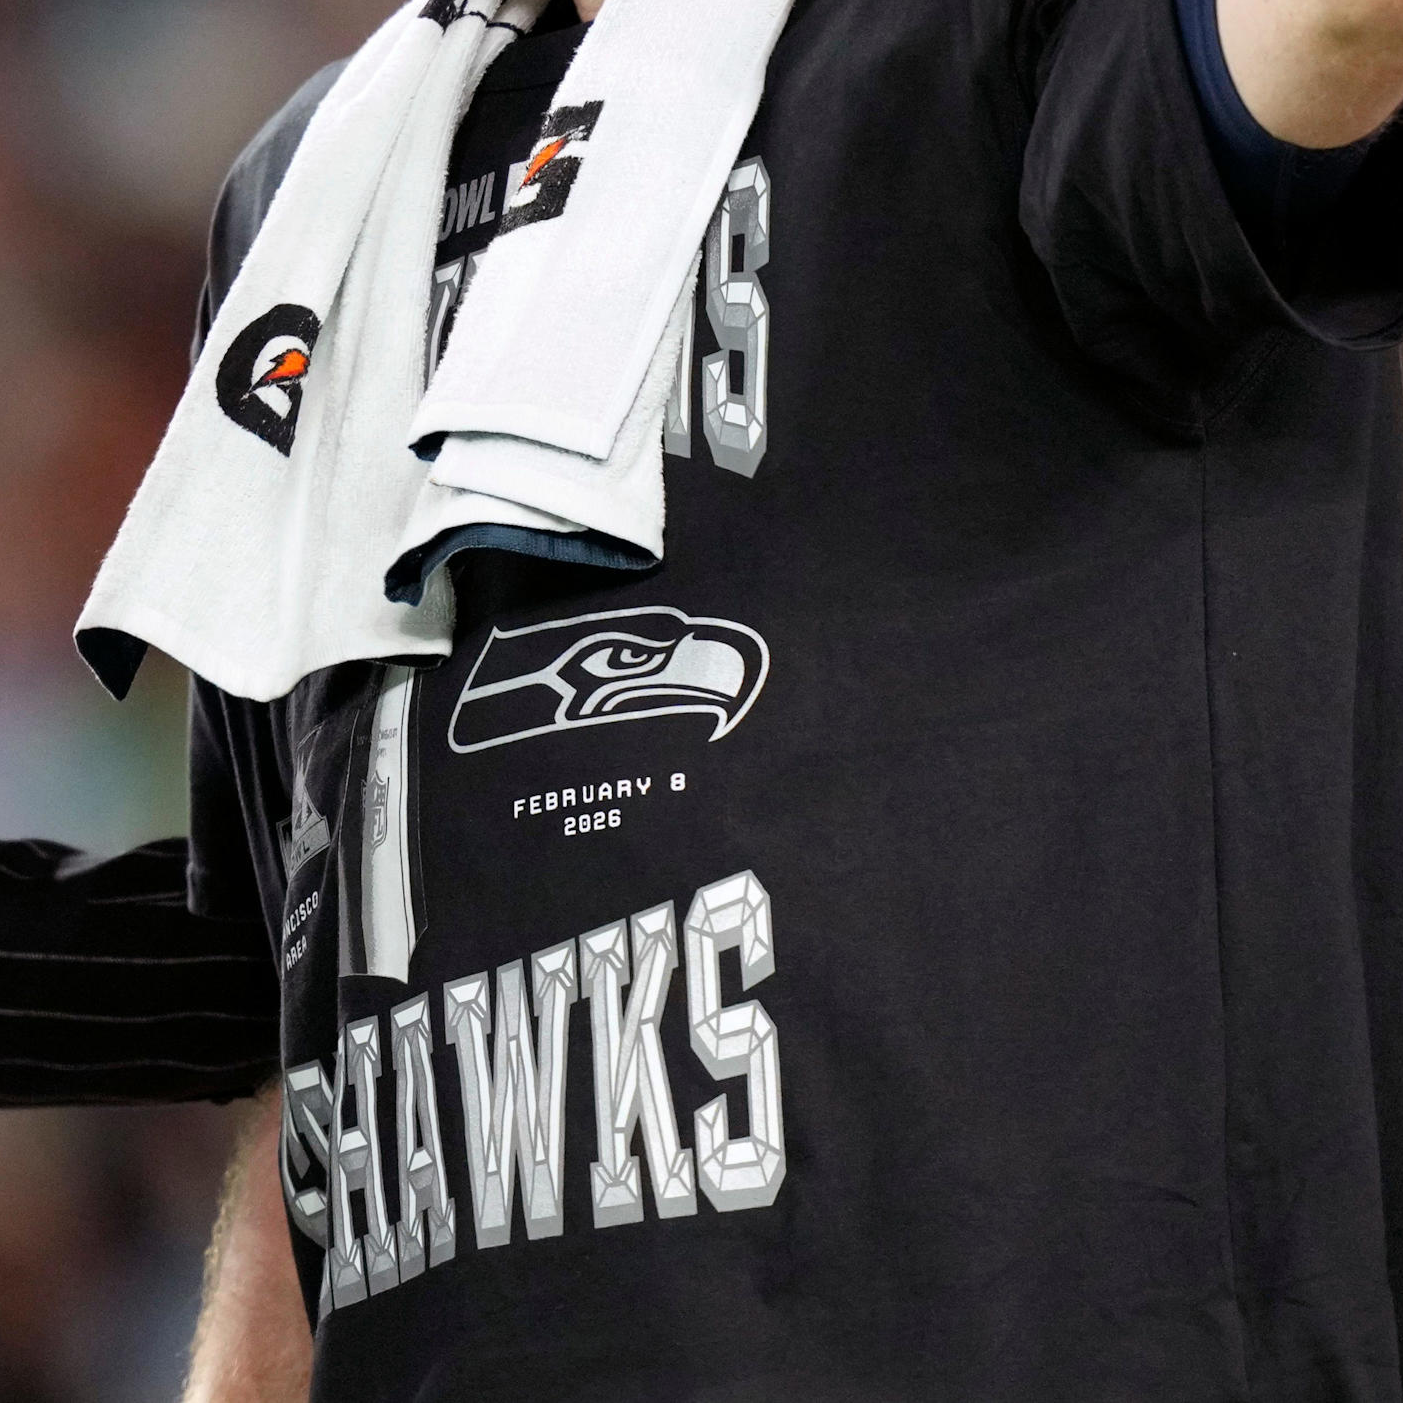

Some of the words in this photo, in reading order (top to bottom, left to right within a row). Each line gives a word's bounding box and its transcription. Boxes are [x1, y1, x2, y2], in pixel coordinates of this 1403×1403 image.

[438, 171, 496, 242] OWL
[513, 776, 652, 819] FEBRUARY
[670, 772, 687, 792] 8
[564, 808, 622, 837] 2026
[285, 935, 308, 971] AREA
